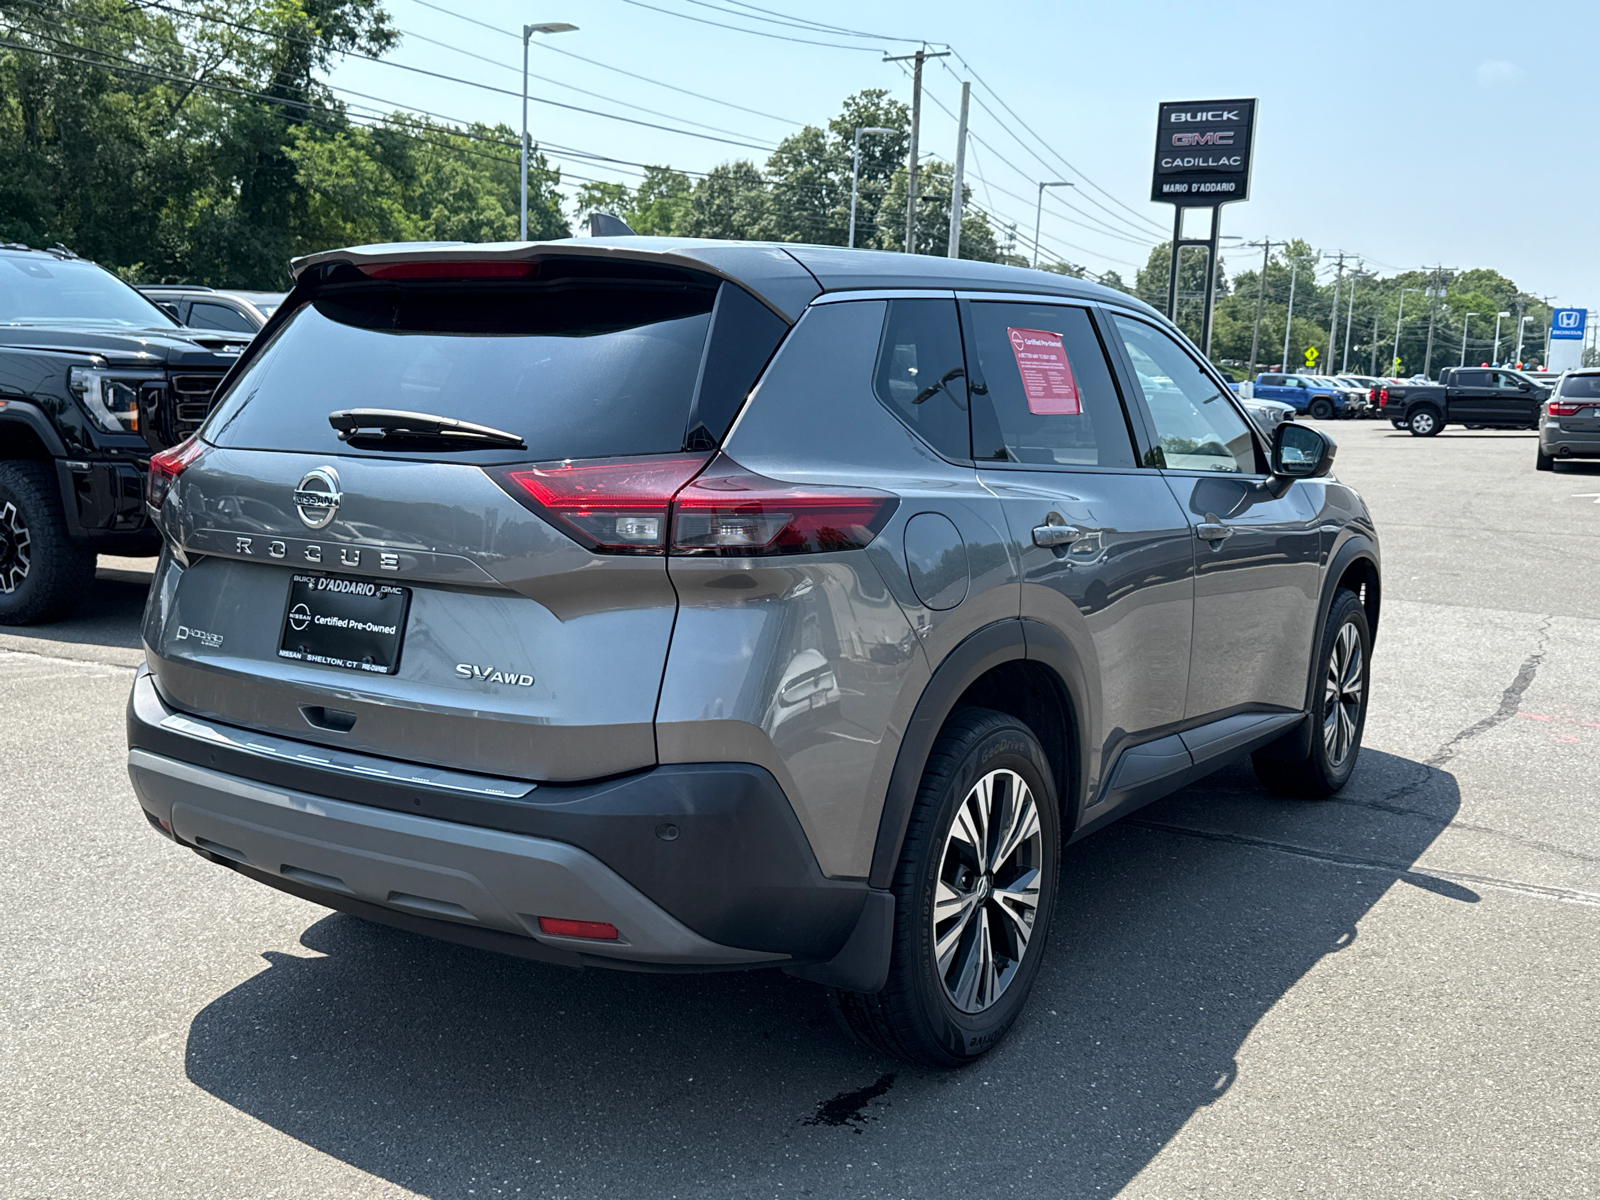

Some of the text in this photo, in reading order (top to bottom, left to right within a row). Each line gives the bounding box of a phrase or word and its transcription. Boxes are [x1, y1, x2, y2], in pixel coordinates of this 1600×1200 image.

[1170, 111, 1240, 122] BUICK
[1172, 132, 1234, 146] GMC
[1161, 157, 1241, 167] CADILLAC
[1162, 183, 1236, 193] MARIO D'ADDARIO
[236, 537, 401, 571] ROGUE
[293, 575, 402, 596] BUICK D'ADDARIO GMC
[314, 615, 396, 634] Certified Pre-Owned
[279, 650, 302, 659] NISSAN
[306, 654, 345, 667] SHELTON,
[361, 663, 388, 673] PRE-OWNED
[455, 663, 535, 687] SV AWD
[981, 737, 1026, 764] GeoDrive
